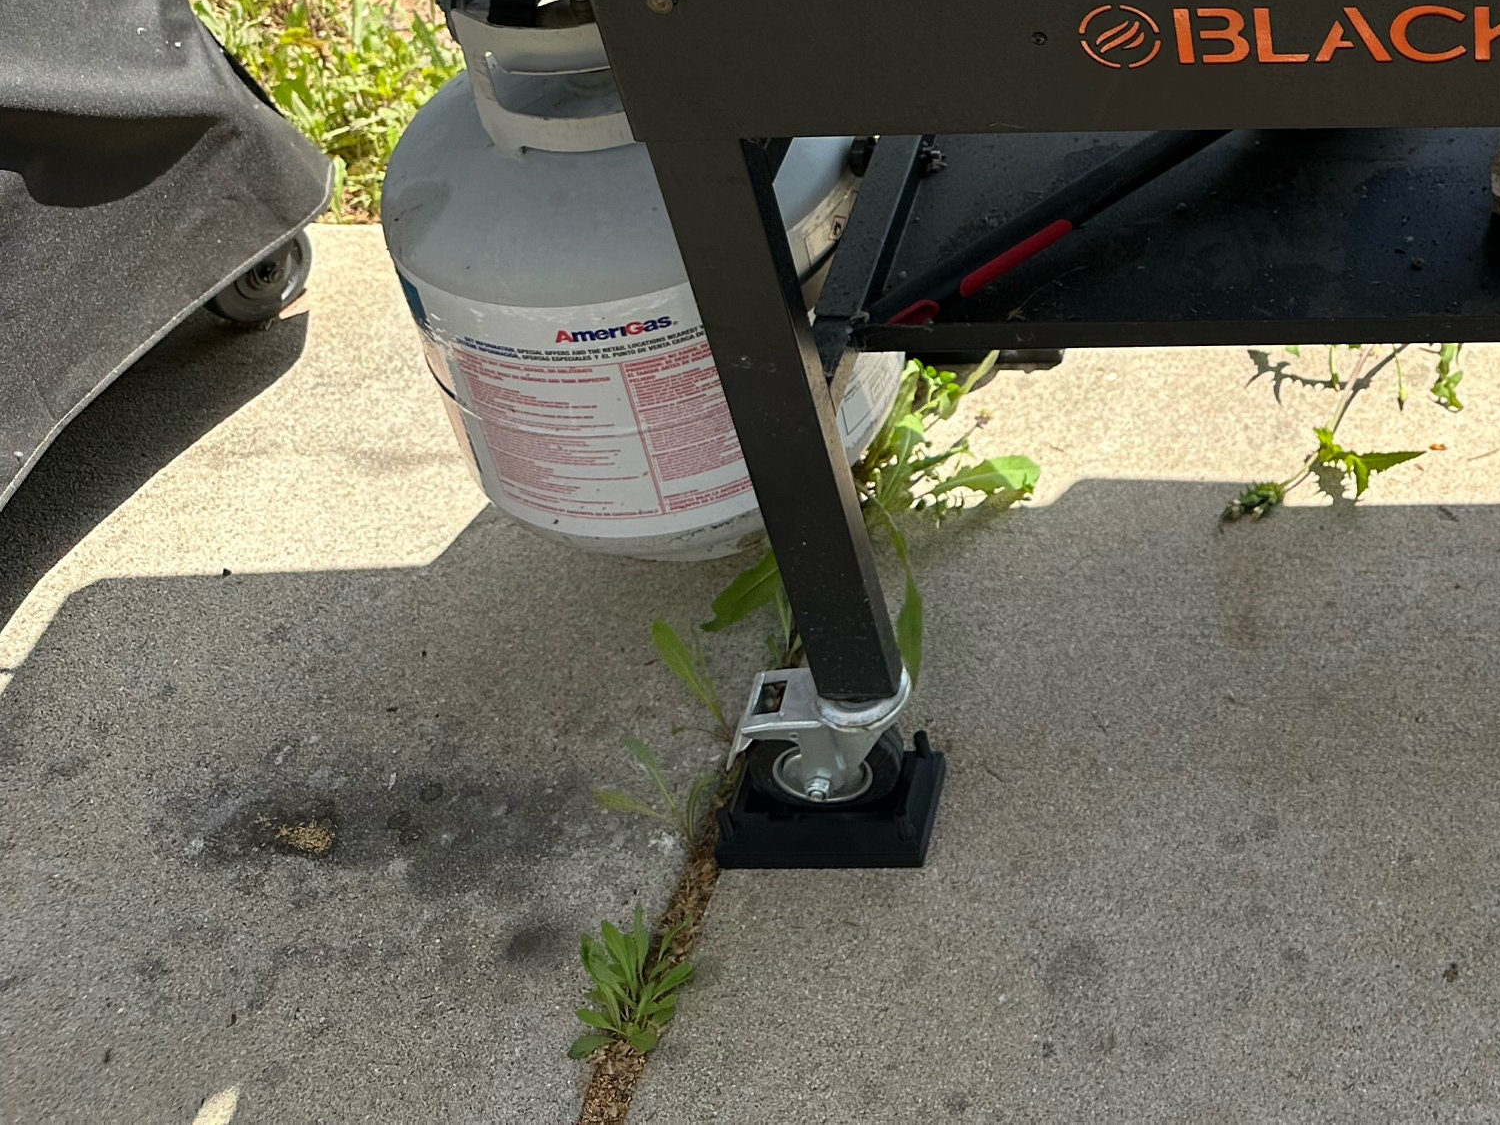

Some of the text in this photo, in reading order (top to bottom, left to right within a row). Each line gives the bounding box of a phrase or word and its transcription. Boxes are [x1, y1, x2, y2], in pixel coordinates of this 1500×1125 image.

[555, 315, 673, 344] AmeriGas
[602, 345, 625, 353] RETAIL
[627, 337, 666, 349] LOCATIONS
[612, 349, 636, 357] PUNTO
[648, 342, 671, 352] VENTA
